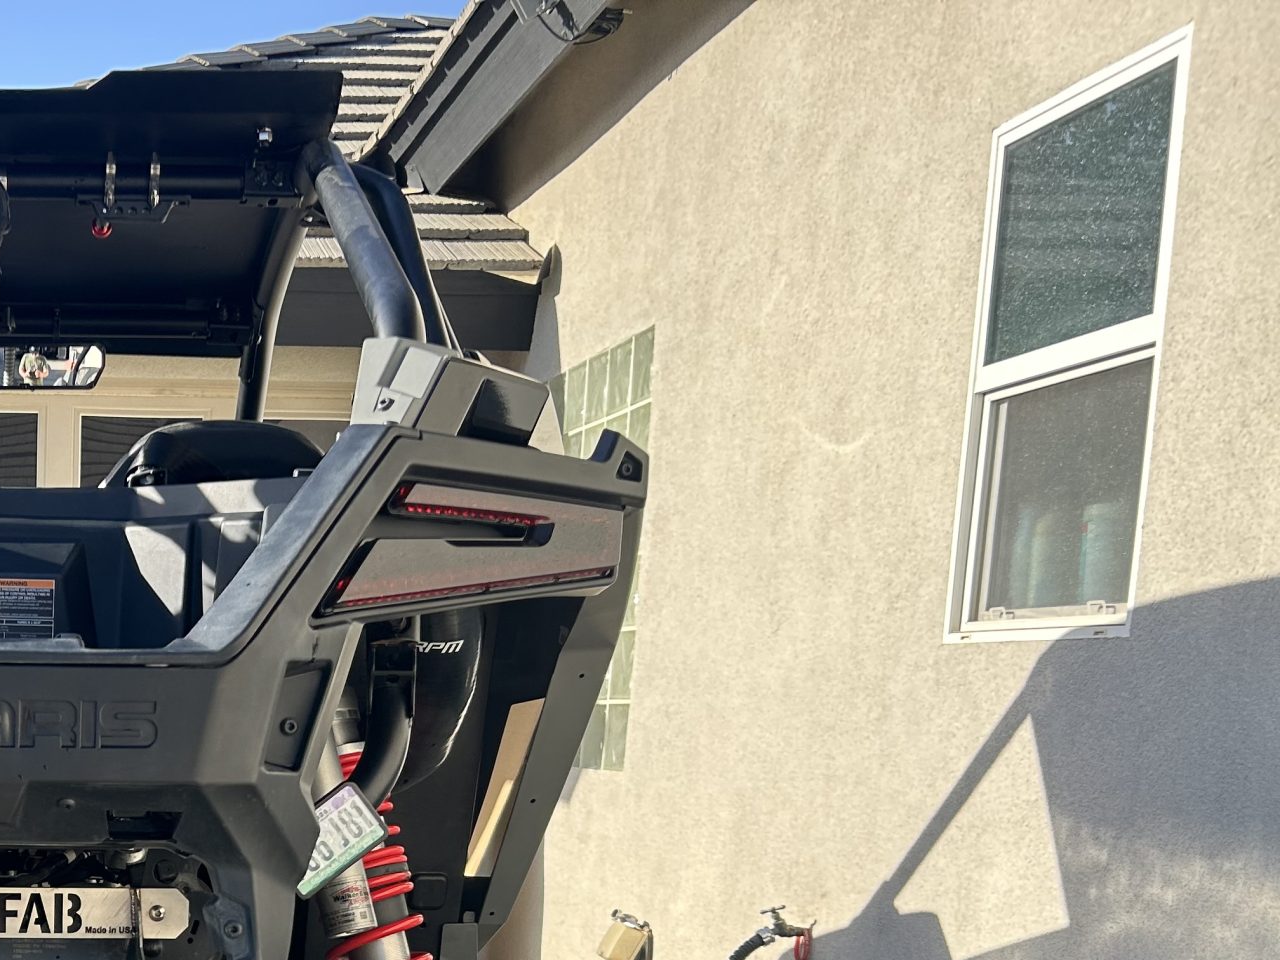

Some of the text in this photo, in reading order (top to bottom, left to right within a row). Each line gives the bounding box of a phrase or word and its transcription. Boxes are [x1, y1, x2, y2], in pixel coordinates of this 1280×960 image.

[415, 640, 464, 654] RPM
[85, 926, 107, 934] Made
[108, 926, 117, 934] in
